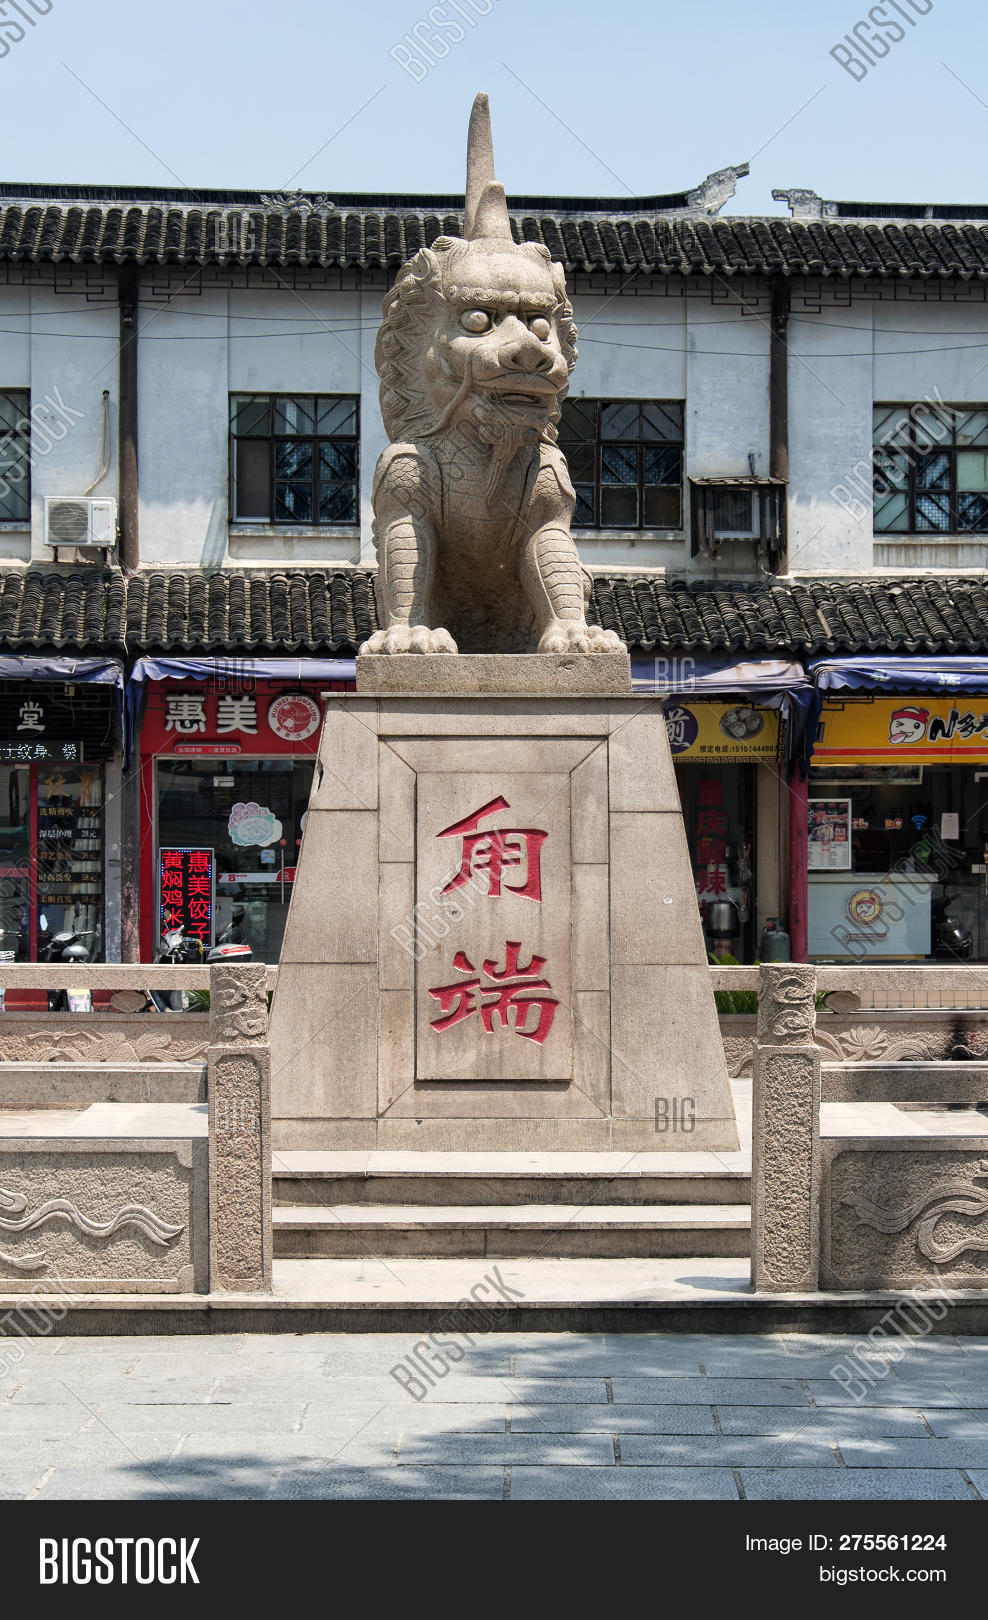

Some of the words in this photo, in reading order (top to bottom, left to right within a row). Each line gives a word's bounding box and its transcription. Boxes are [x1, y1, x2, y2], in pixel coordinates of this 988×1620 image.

[17, 701, 46, 732] 堂
[165, 694, 258, 735] 惠美
[271, 697, 289, 718] HUIMEI
[291, 695, 318, 722] DUMPLING
[666, 708, 691, 747] 煎
[187, 851, 210, 941] 惠美饺子
